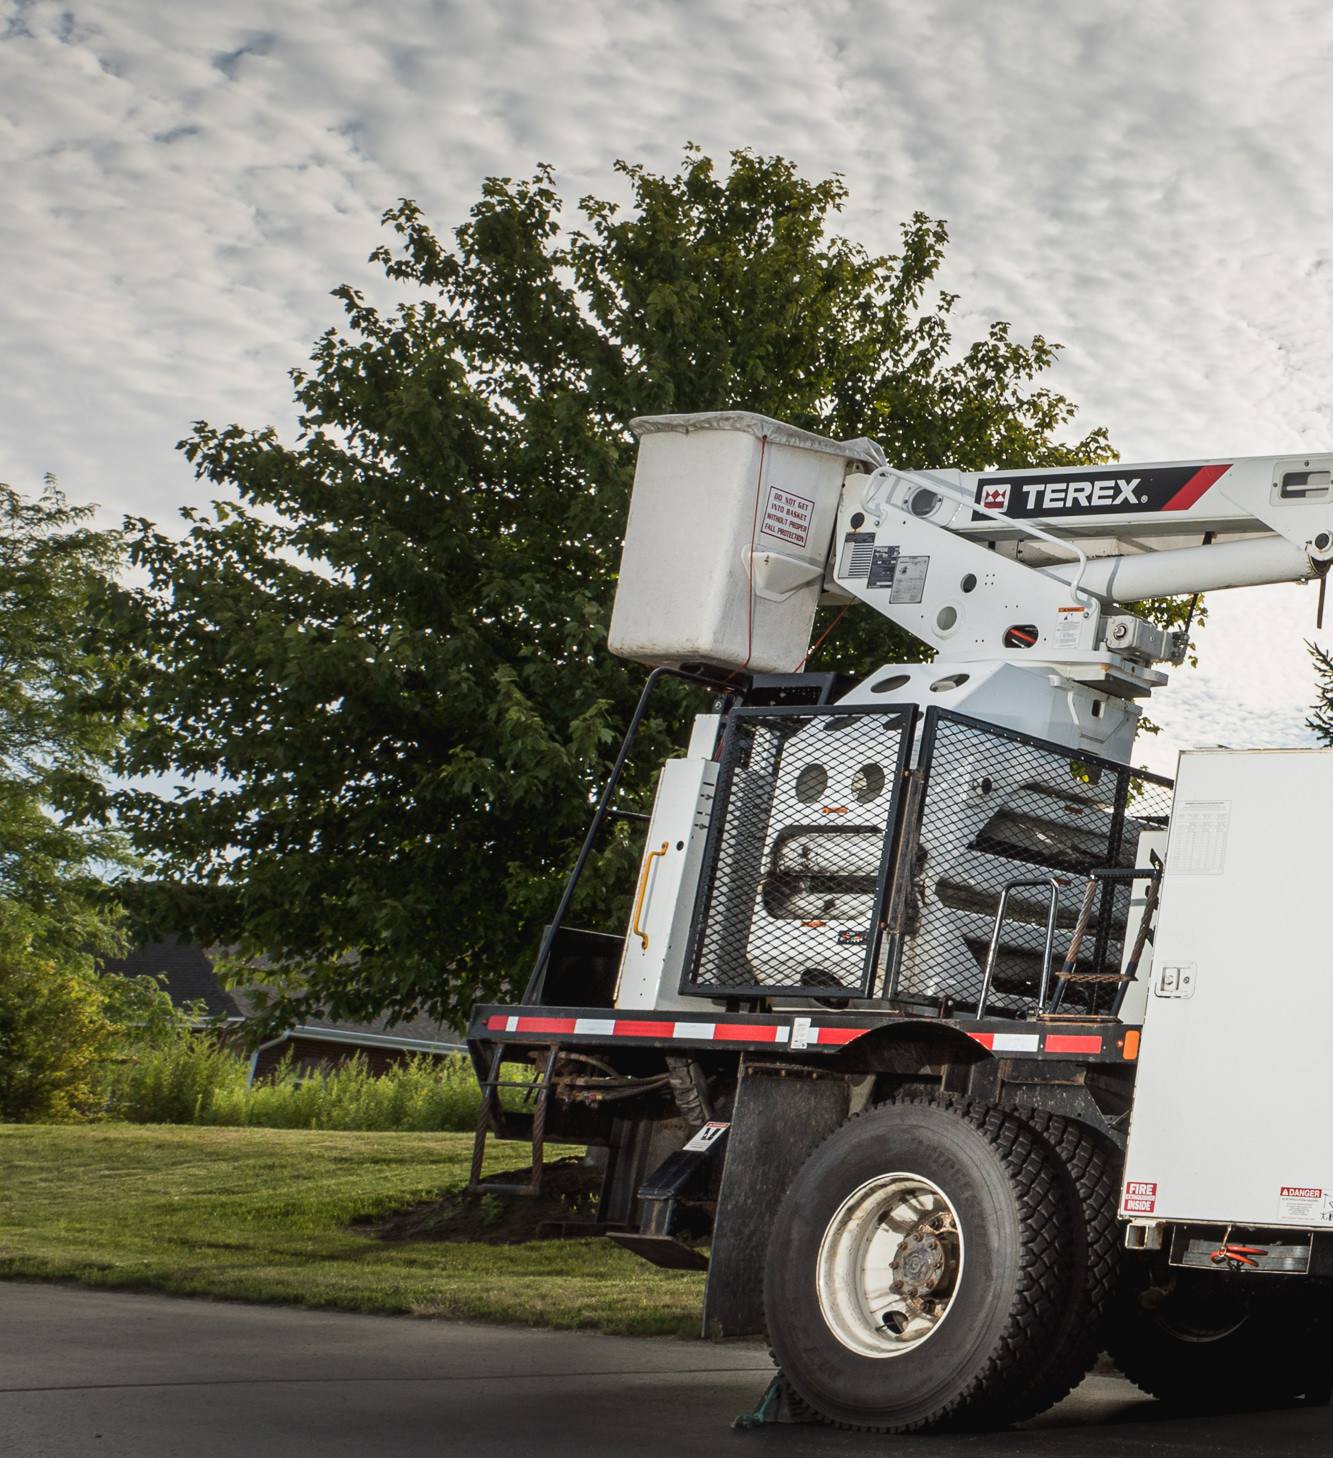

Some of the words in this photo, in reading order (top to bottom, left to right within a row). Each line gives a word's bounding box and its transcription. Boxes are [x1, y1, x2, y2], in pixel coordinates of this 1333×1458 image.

[774, 492, 783, 502] DO
[785, 496, 797, 507] NOT
[798, 501, 809, 511] GET
[1022, 478, 1142, 510] TEREX
[771, 503, 785, 513] INTO
[786, 508, 807, 521] BASKET
[767, 512, 788, 525] WITHOUT
[789, 520, 807, 533] PROPER
[764, 523, 775, 533] FALL
[777, 527, 804, 543] PROTECTION
[1129, 1183, 1154, 1195] FIRE
[1289, 1188, 1320, 1198] DANGER
[1127, 1200, 1152, 1211] INSIDE
